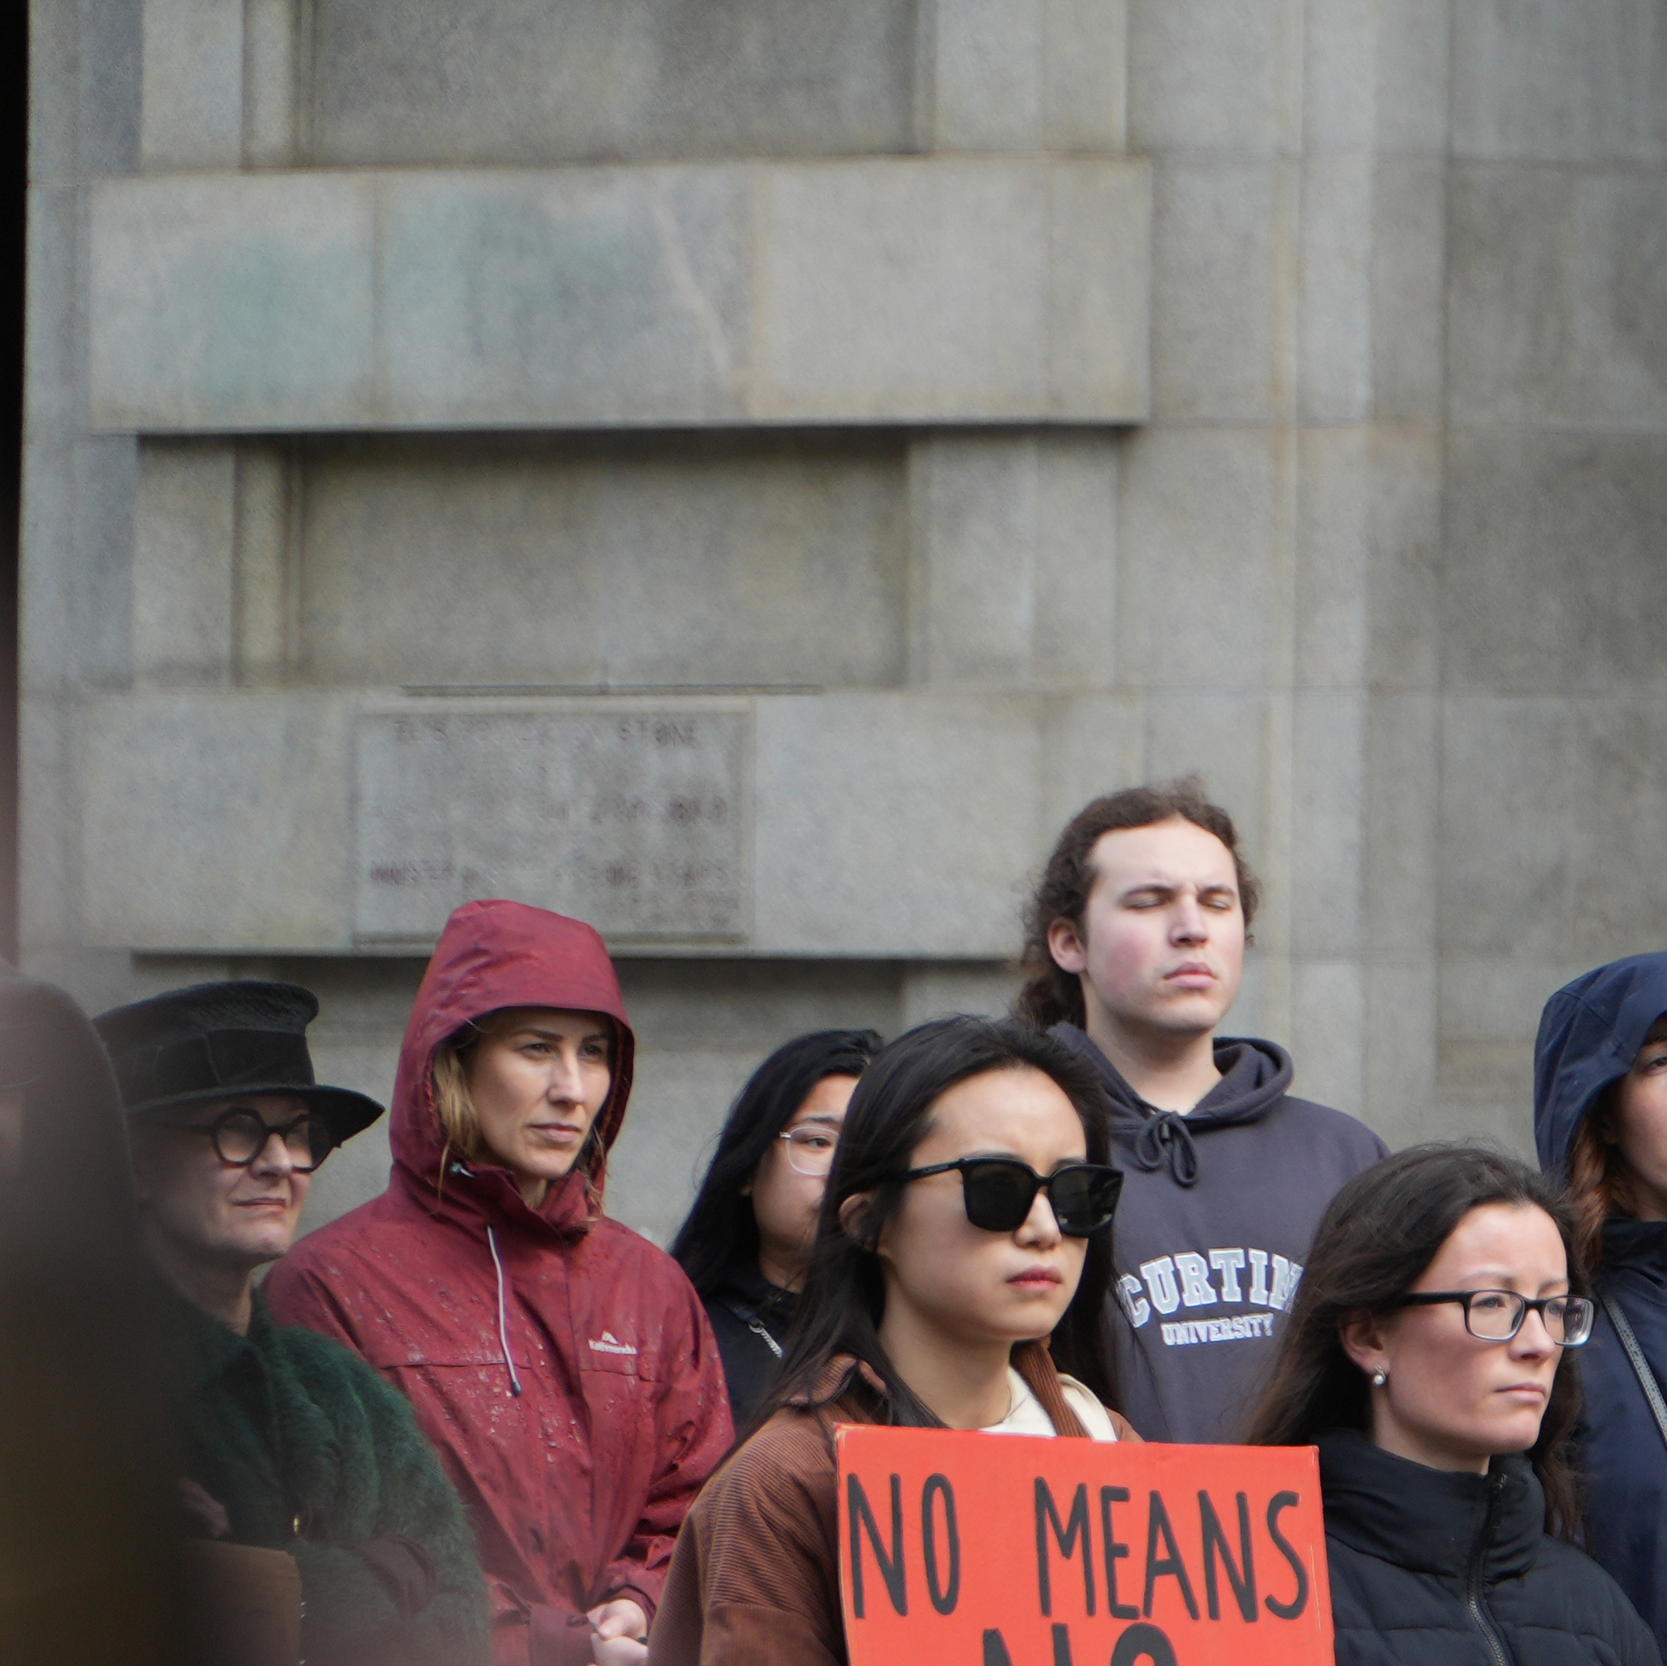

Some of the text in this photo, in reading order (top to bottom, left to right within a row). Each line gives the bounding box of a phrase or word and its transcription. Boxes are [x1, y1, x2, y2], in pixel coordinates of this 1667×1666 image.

[1115, 1247, 1304, 1328] CURTIN
[1161, 1312, 1273, 1346] UNIVERSITY
[847, 1472, 1308, 1622] NO MEANS
